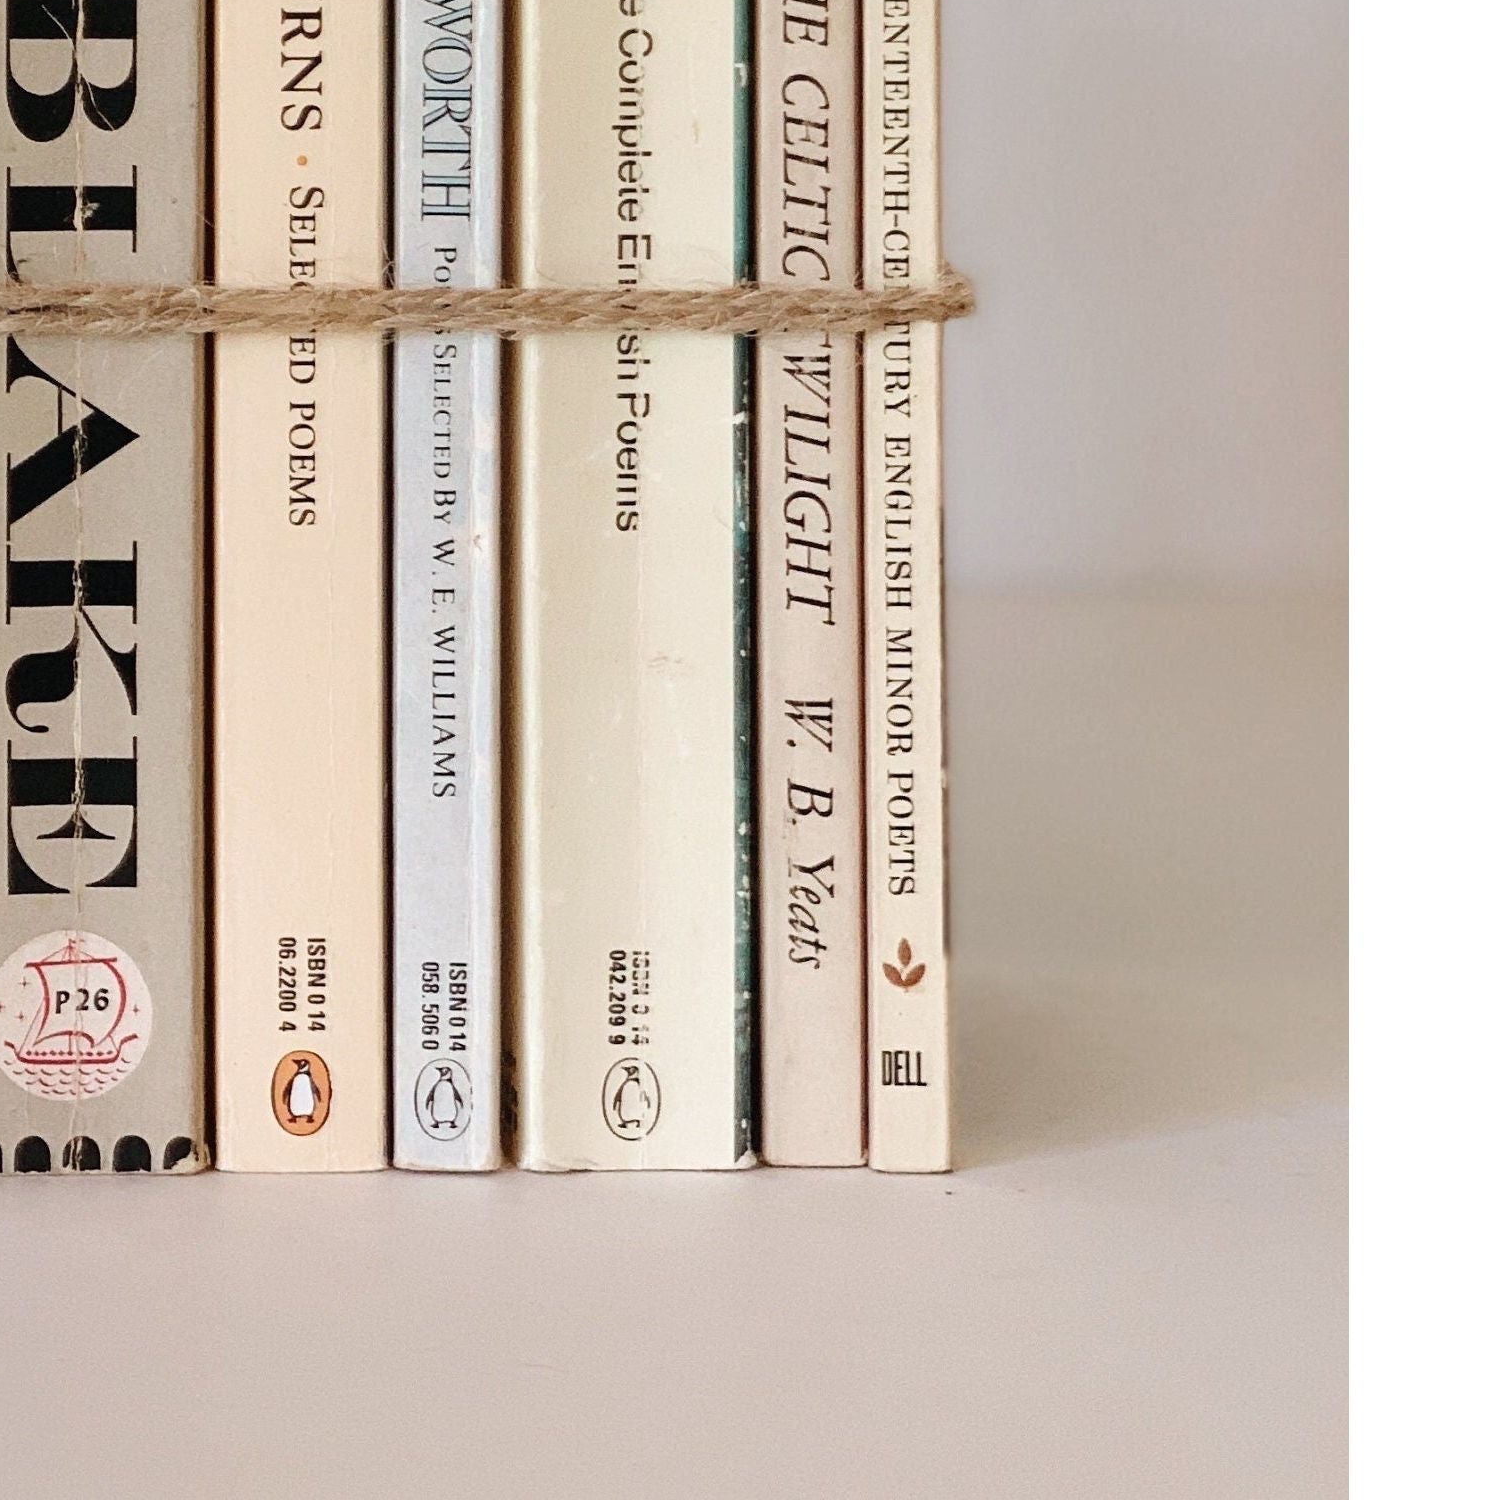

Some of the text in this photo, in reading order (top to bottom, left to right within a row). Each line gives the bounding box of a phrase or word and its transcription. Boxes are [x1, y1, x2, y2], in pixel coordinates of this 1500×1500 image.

[780, 73, 832, 281] CELTIC
[289, 402, 317, 528] POEMS
[615, 392, 651, 533] Poems
[883, 433, 913, 612] ENGLISH
[432, 625, 456, 800] WILLIAMS
[885, 627, 914, 757] MINOR
[886, 770, 917, 897] POETS
[307, 937, 327, 988] ISBN
[786, 855, 837, 971] Yeats
[449, 963, 468, 1012] ISBN
[882, 1050, 927, 1087] DELL
